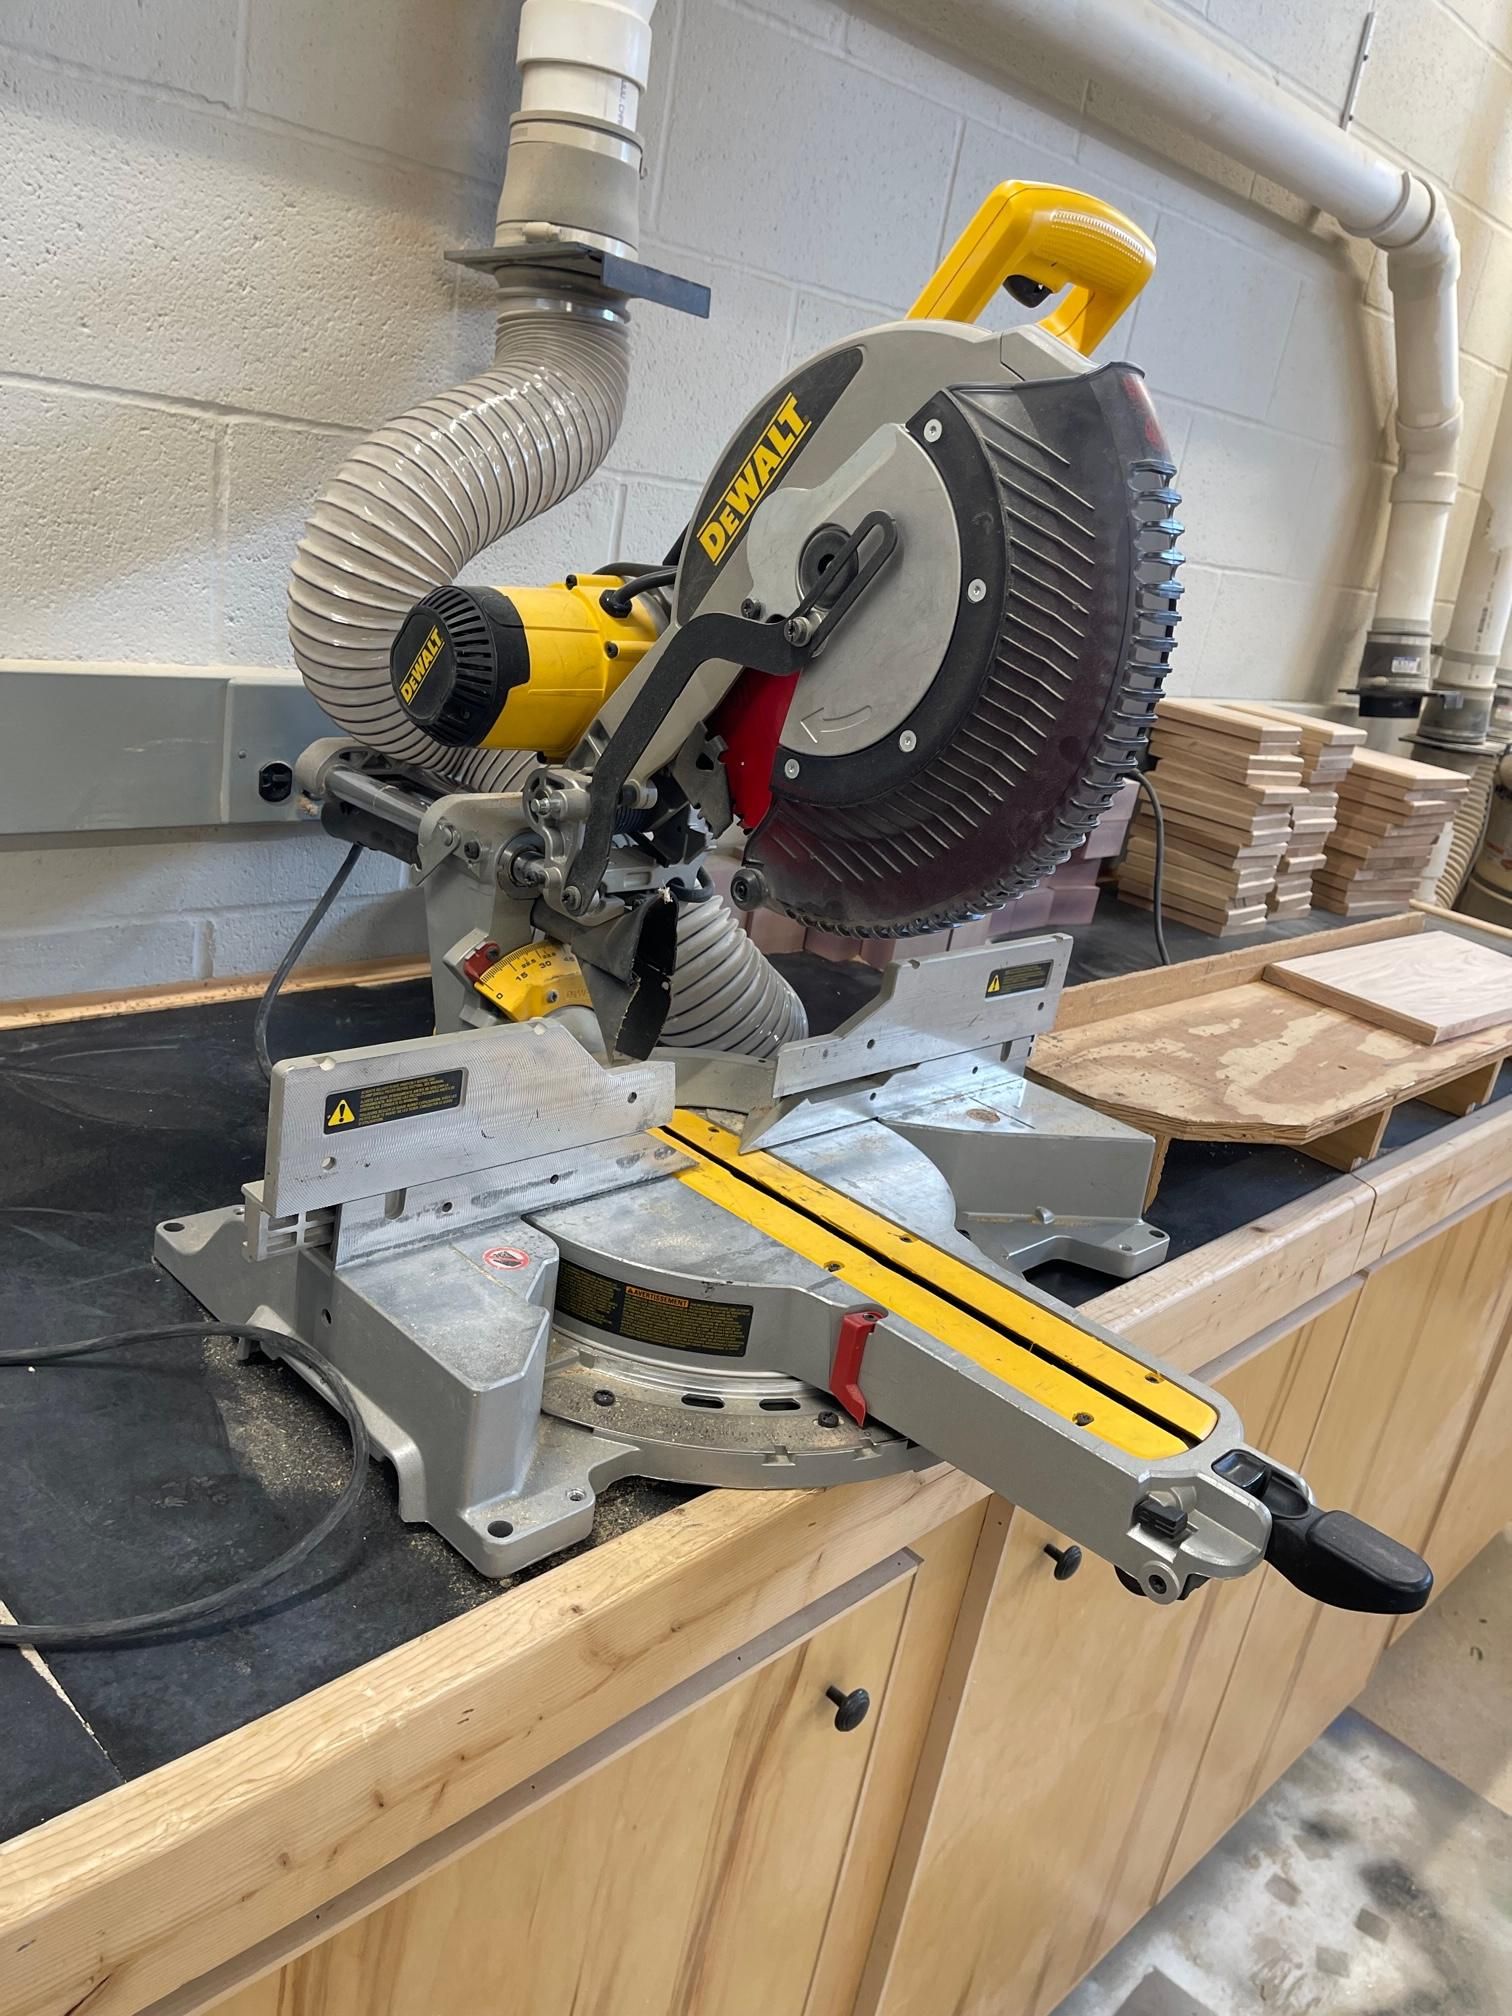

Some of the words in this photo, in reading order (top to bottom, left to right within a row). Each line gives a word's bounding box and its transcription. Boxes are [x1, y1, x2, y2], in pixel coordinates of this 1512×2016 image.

[698, 395, 806, 562] DEWALT
[400, 627, 443, 703] DEWALT
[539, 960, 552, 969] 30
[516, 972, 528, 982] 15
[633, 1289, 688, 1307] AVERTISSEMENT
